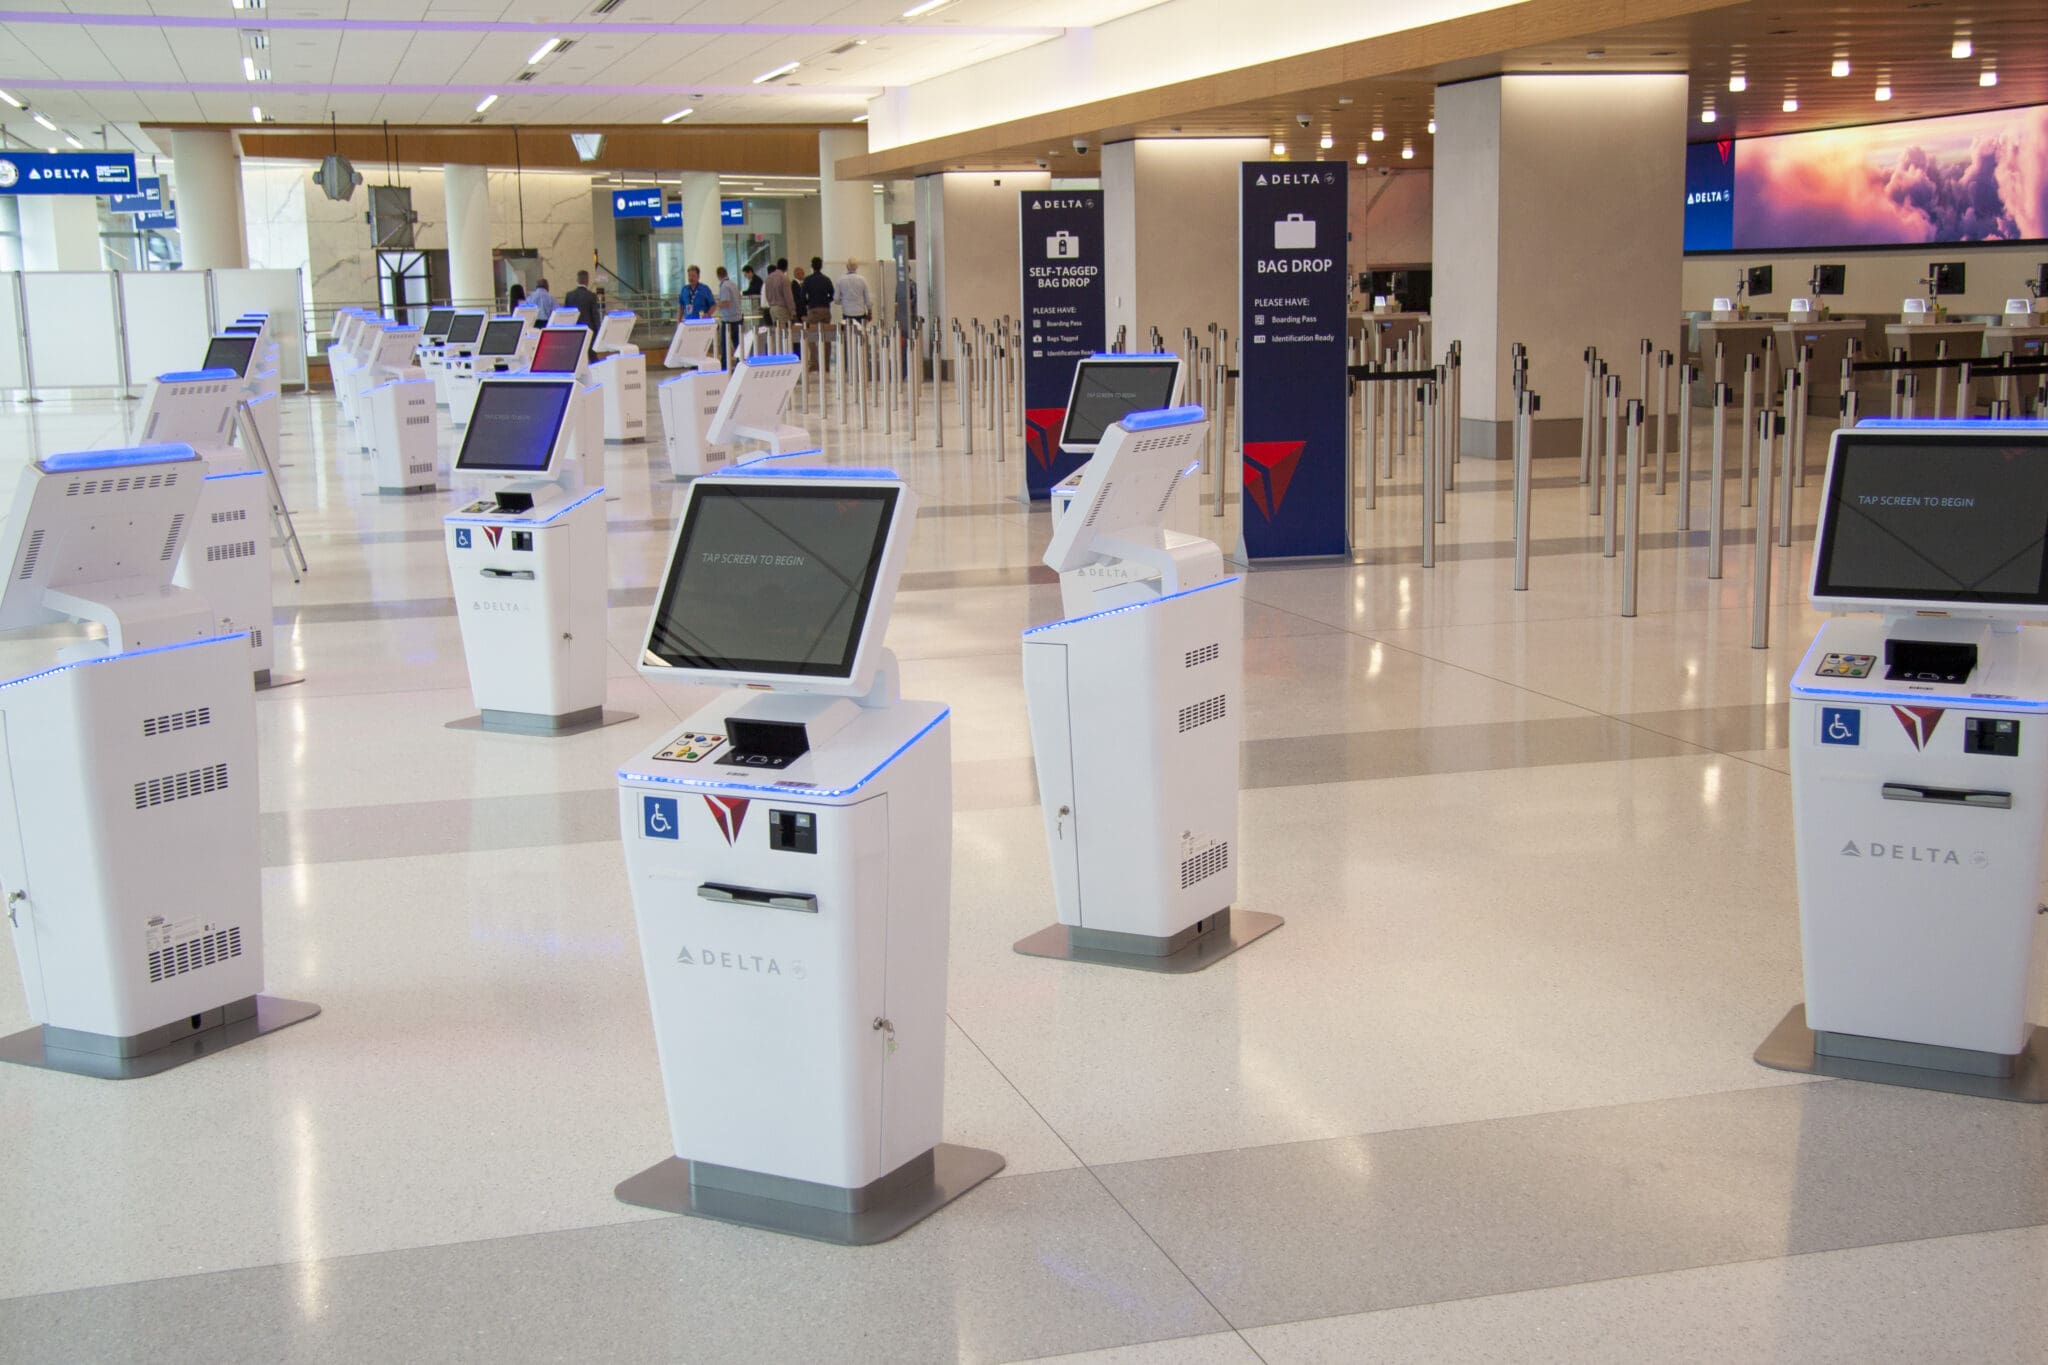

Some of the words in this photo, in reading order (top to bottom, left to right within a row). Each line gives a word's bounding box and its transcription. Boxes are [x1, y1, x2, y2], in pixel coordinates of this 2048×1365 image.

[43, 168, 90, 179] DELTA
[1272, 174, 1320, 185] DELTA
[1695, 191, 1722, 203] DELTA
[1044, 200, 1083, 209] DELTA
[1257, 259, 1288, 273] BAG
[1291, 258, 1333, 273] DROP
[1029, 266, 1098, 277] SELF-TAGGED
[1038, 278, 1060, 288] BAG
[1061, 277, 1091, 288] DROP
[1254, 298, 1284, 307] PLEASE
[1285, 297, 1310, 306] HAVE:
[1056, 306, 1077, 314] HAVE:
[1046, 320, 1070, 328] Boarding
[1271, 315, 1301, 324] Boarding
[1301, 314, 1317, 323] Pass
[1060, 335, 1079, 343] Tagged
[1271, 334, 1314, 342] Identification
[1314, 333, 1335, 343] Ready
[1858, 495, 1878, 505] TAP
[1880, 496, 1920, 506] SCREEN
[1923, 496, 1939, 507] TO
[1941, 497, 1975, 507] BEGIN
[702, 552, 720, 563] TAP
[721, 553, 757, 565] SCREEN
[759, 554, 774, 565] TO
[775, 555, 805, 566] BEGIN
[1089, 568, 1128, 578] DELTA
[483, 601, 520, 612] DELTA
[1870, 842, 1961, 865] DELTA
[702, 948, 781, 976] DELTA
